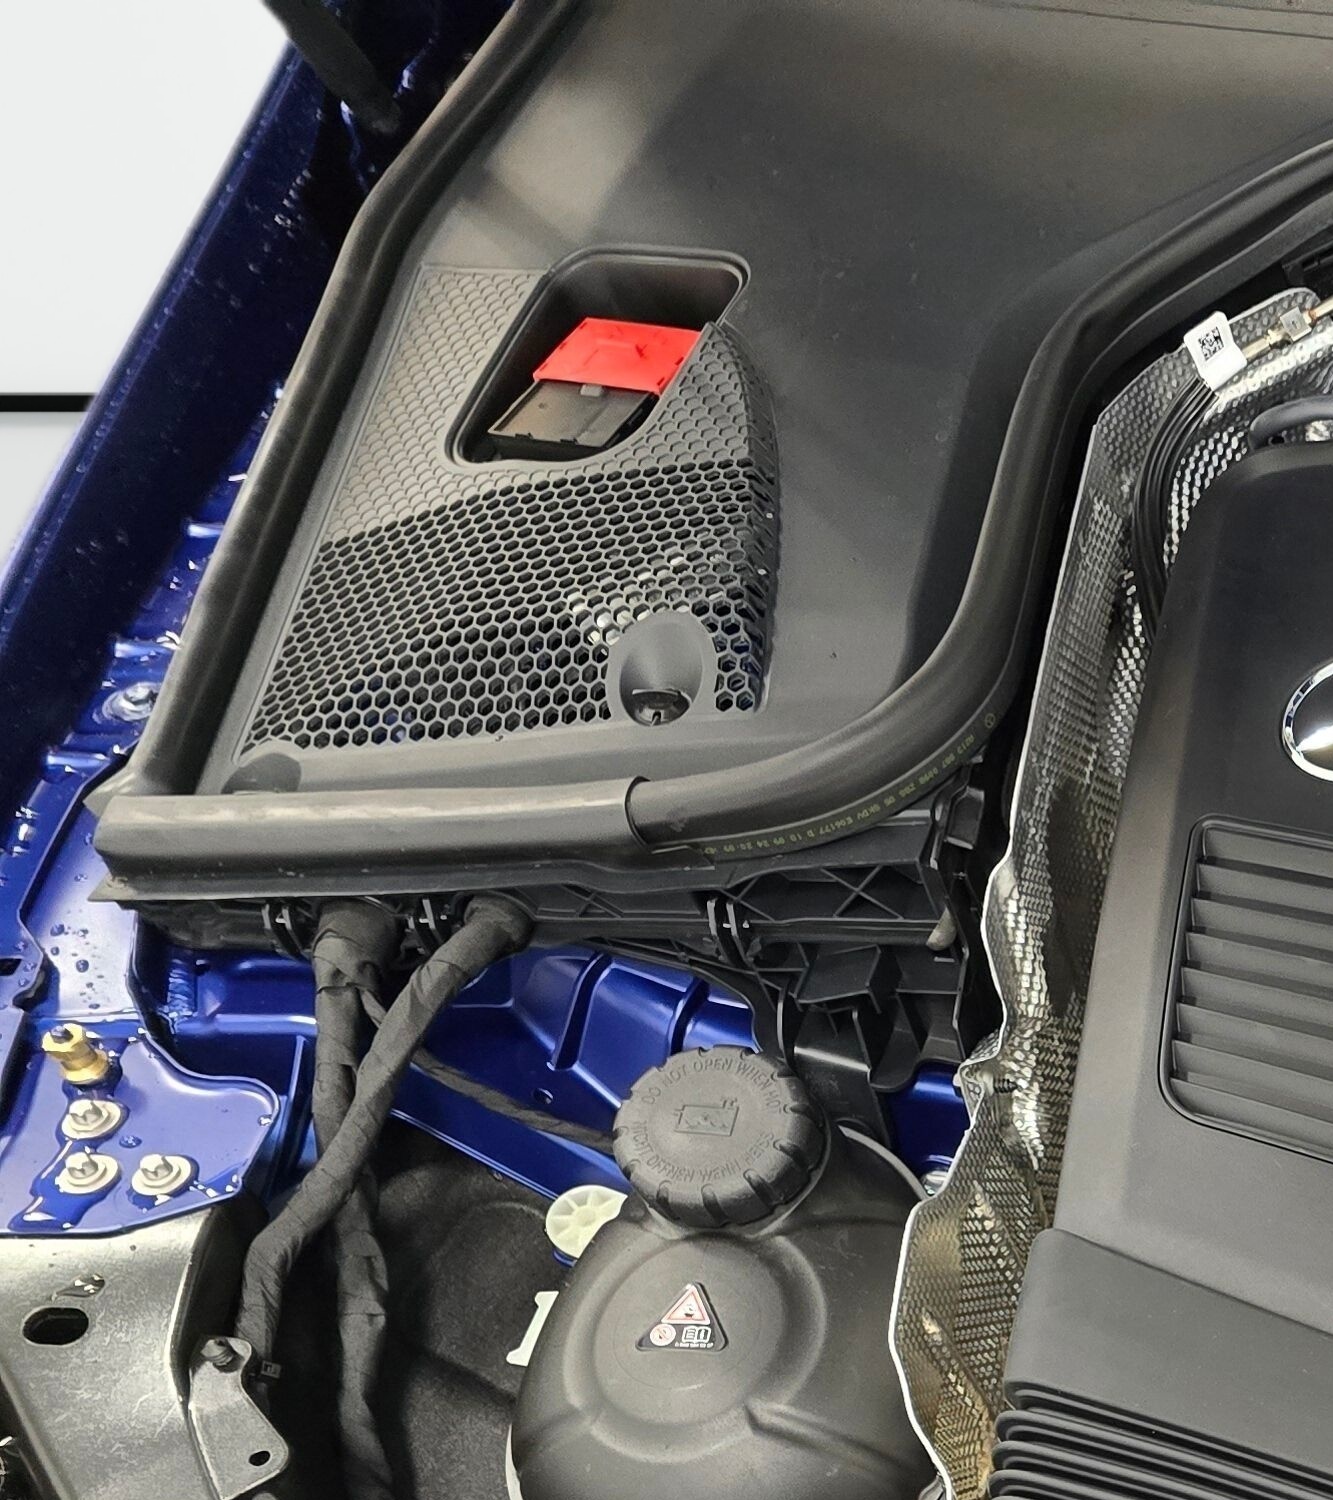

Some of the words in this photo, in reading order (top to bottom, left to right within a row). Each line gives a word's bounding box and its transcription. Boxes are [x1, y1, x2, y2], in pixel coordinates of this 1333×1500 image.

[641, 1086, 662, 1105] DO
[663, 1064, 687, 1088] NOT
[693, 1057, 733, 1073] OPEN
[736, 1061, 774, 1090] WHEN
